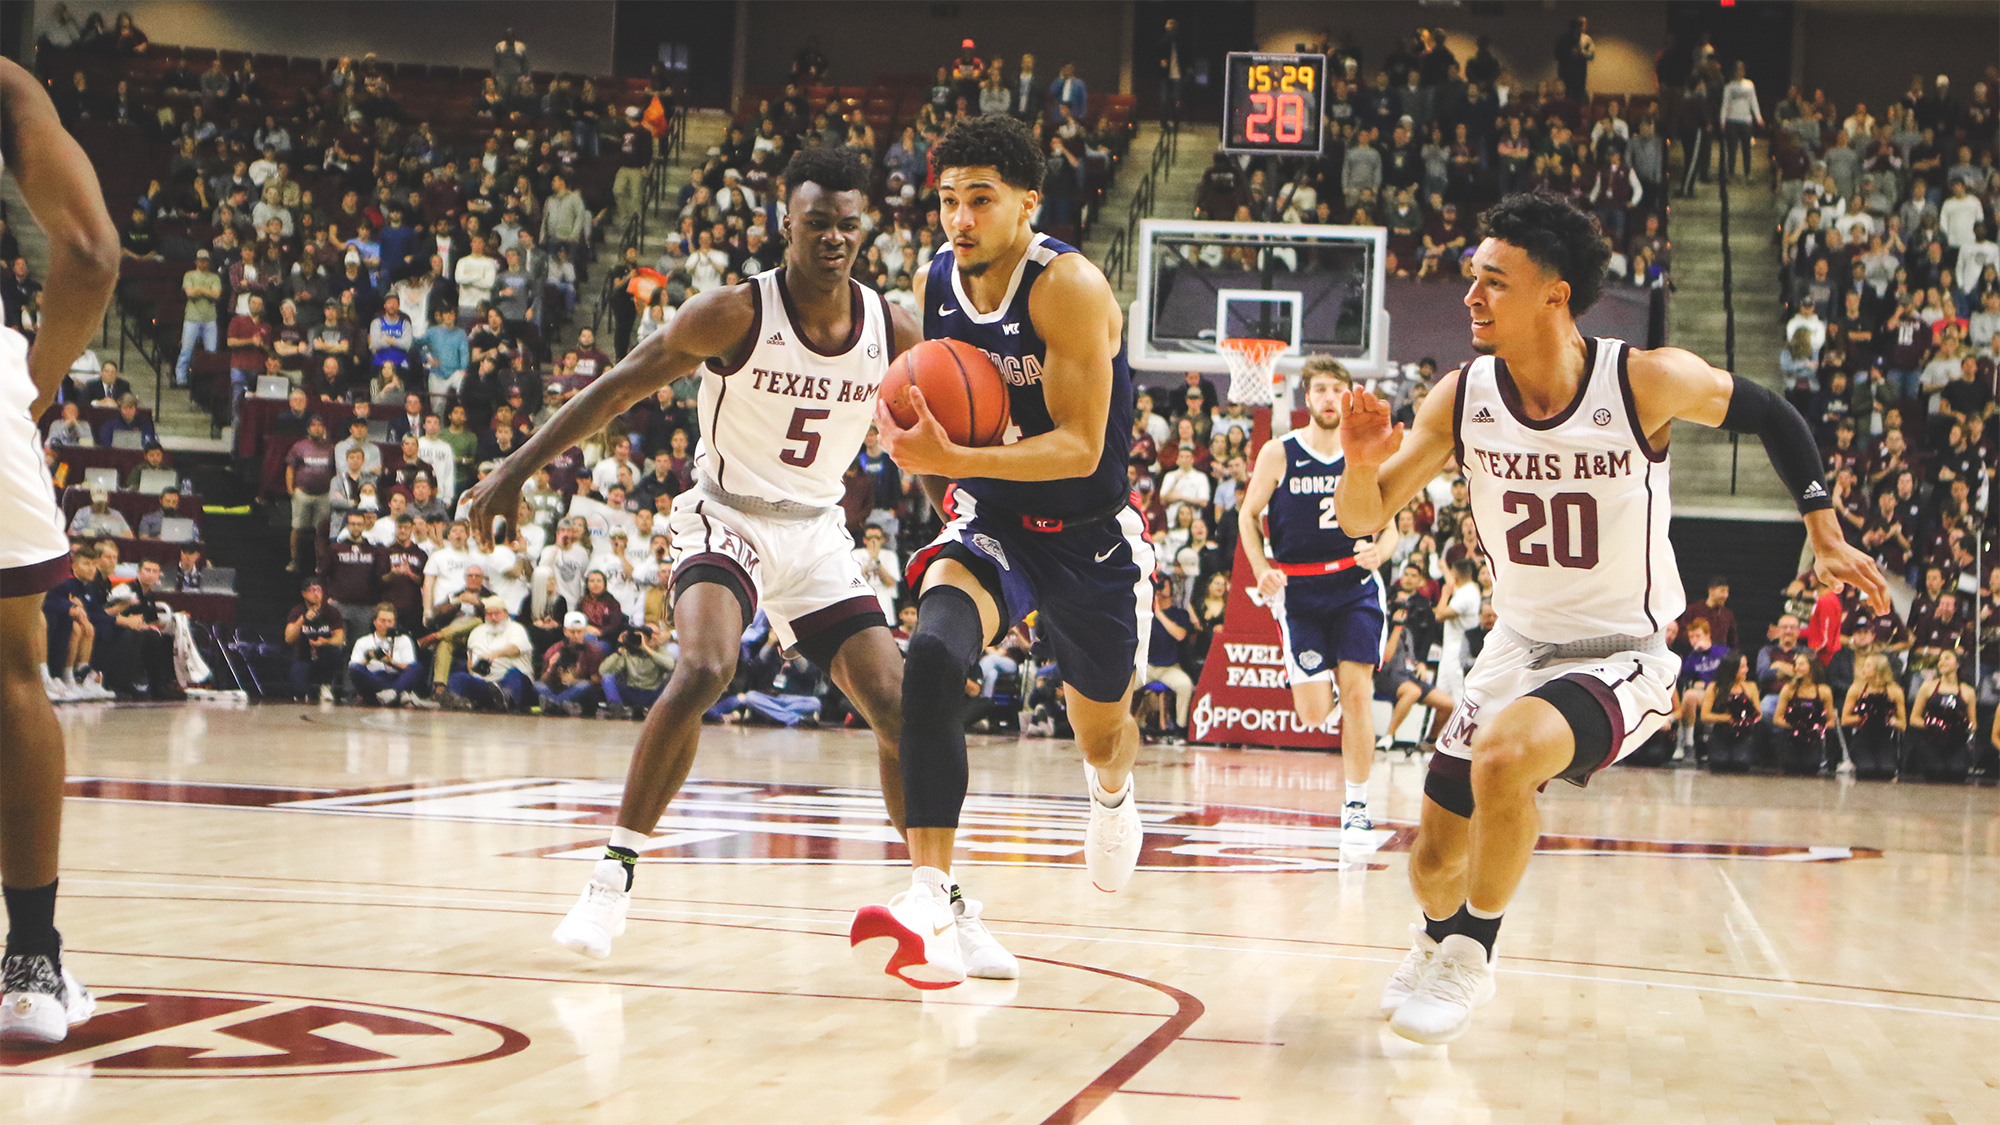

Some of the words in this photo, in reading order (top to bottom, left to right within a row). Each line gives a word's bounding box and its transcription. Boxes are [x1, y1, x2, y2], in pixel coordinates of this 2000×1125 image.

[1248, 65, 1315, 93] 15:29
[1245, 93, 1305, 143] 28
[752, 367, 832, 401] TEXAS
[836, 379, 881, 403] A&M
[1471, 416, 1496, 424] adidas
[778, 406, 831, 469] 5
[1473, 447, 1562, 481] TEXAS
[1573, 449, 1632, 480] A&M
[1802, 489, 1828, 500] adidas
[1502, 489, 1600, 571] 20
[1223, 642, 1285, 666] WEL
